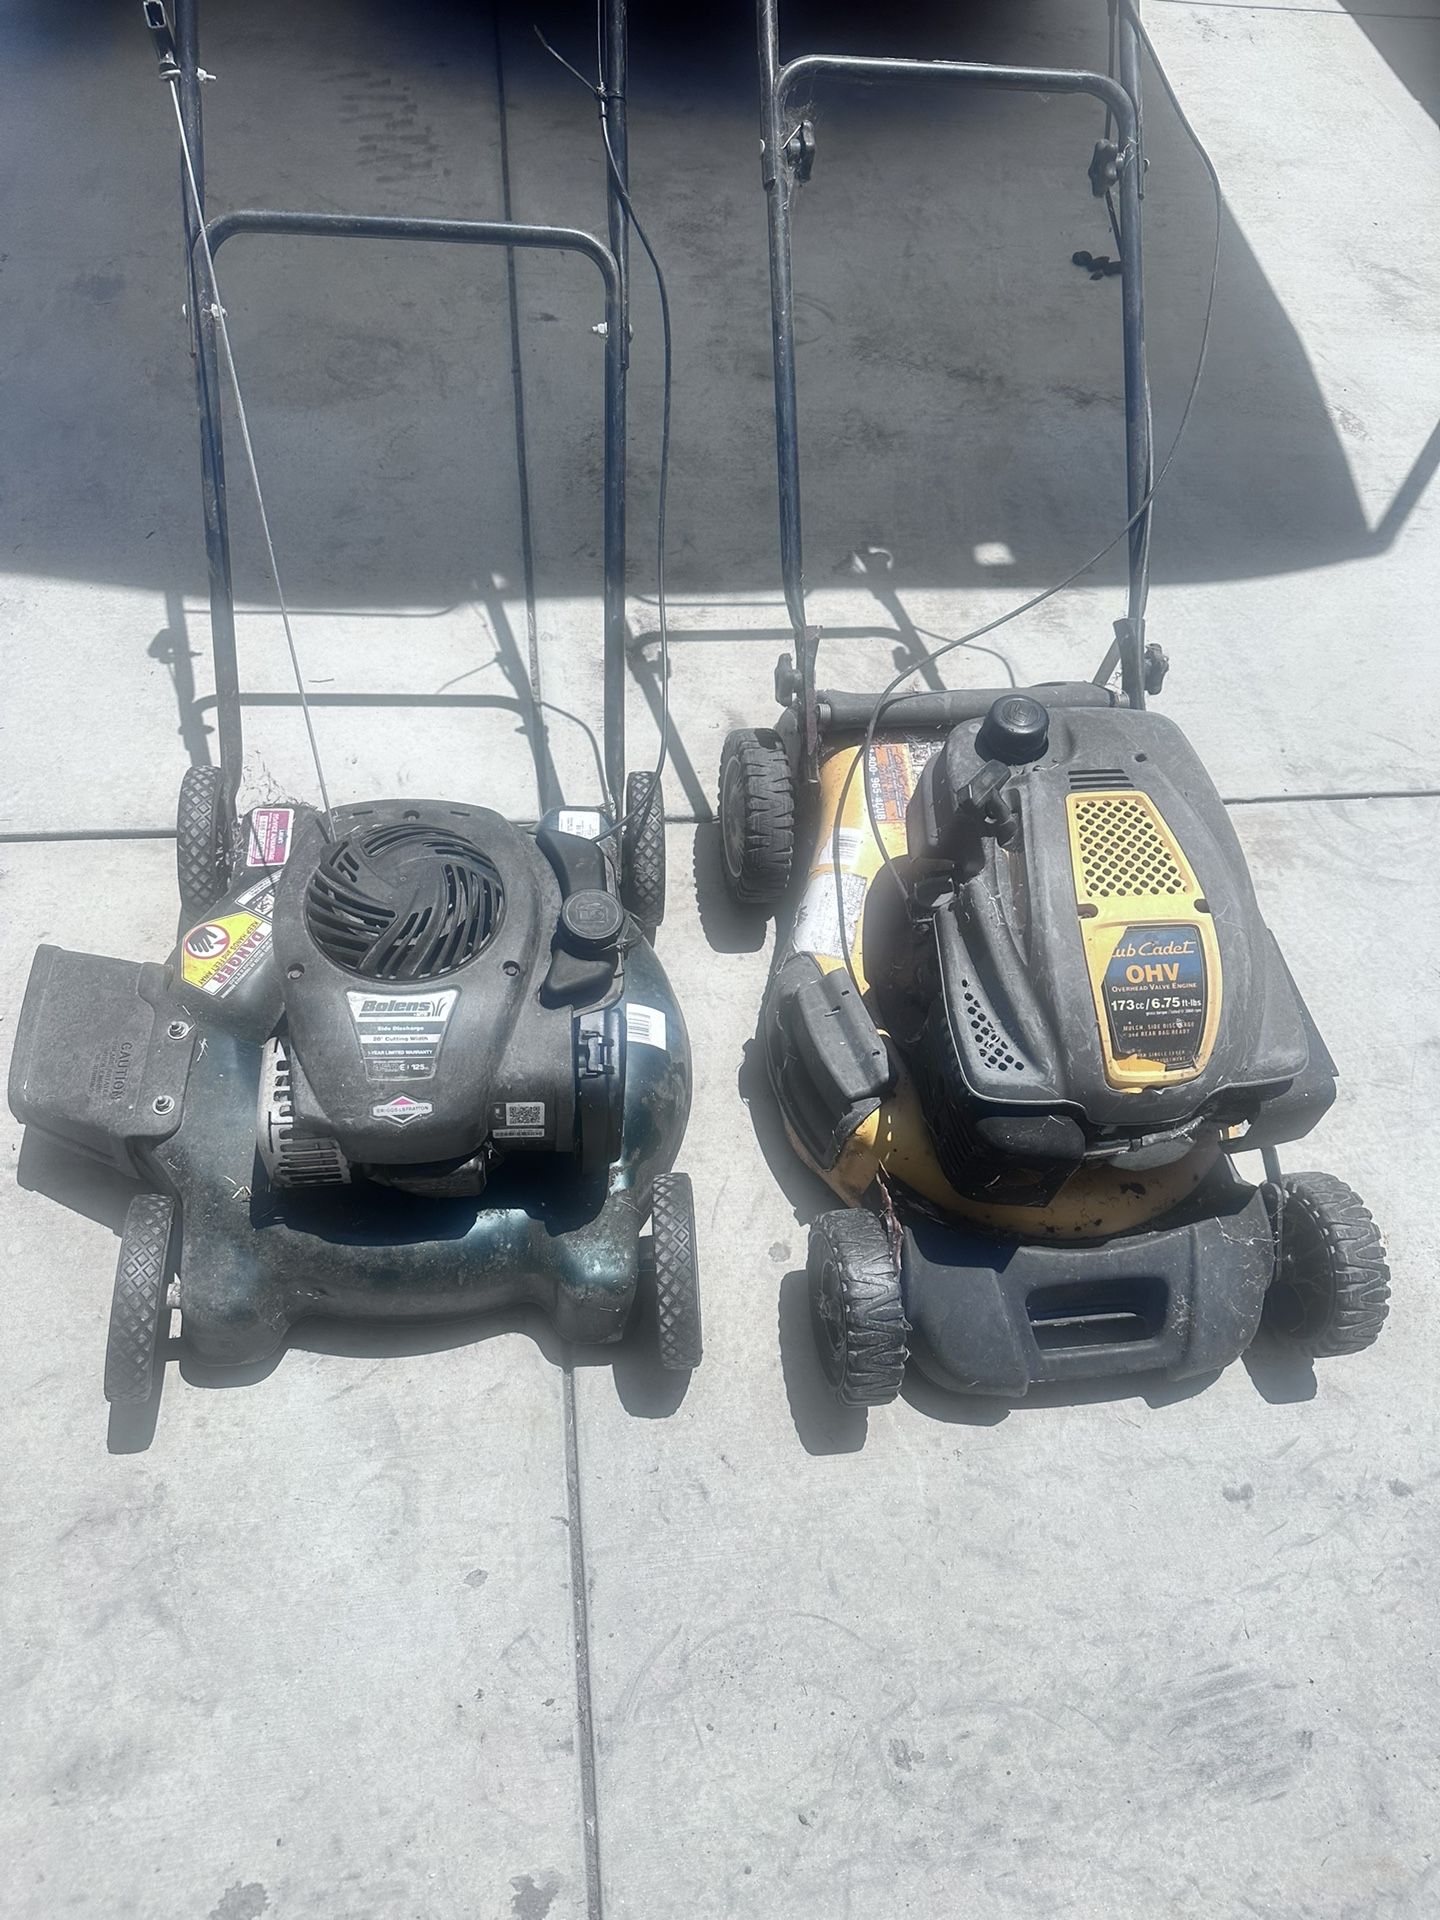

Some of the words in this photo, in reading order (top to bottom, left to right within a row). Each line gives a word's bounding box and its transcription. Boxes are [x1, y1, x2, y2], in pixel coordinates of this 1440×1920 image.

[246, 921, 259, 935] KEEP
[230, 934, 247, 951] HANDS
[1112, 943, 1136, 958] ub
[1138, 940, 1196, 956] Cadet
[213, 931, 266, 984] DANGER
[221, 949, 232, 960] and
[211, 957, 224, 972] FEET
[198, 970, 213, 985] AWAY
[1126, 963, 1180, 984] OHV
[361, 1000, 431, 1012] Bolens
[1163, 1021, 1194, 1029] DISCRGE
[111, 1042, 132, 1099] CAUTION
